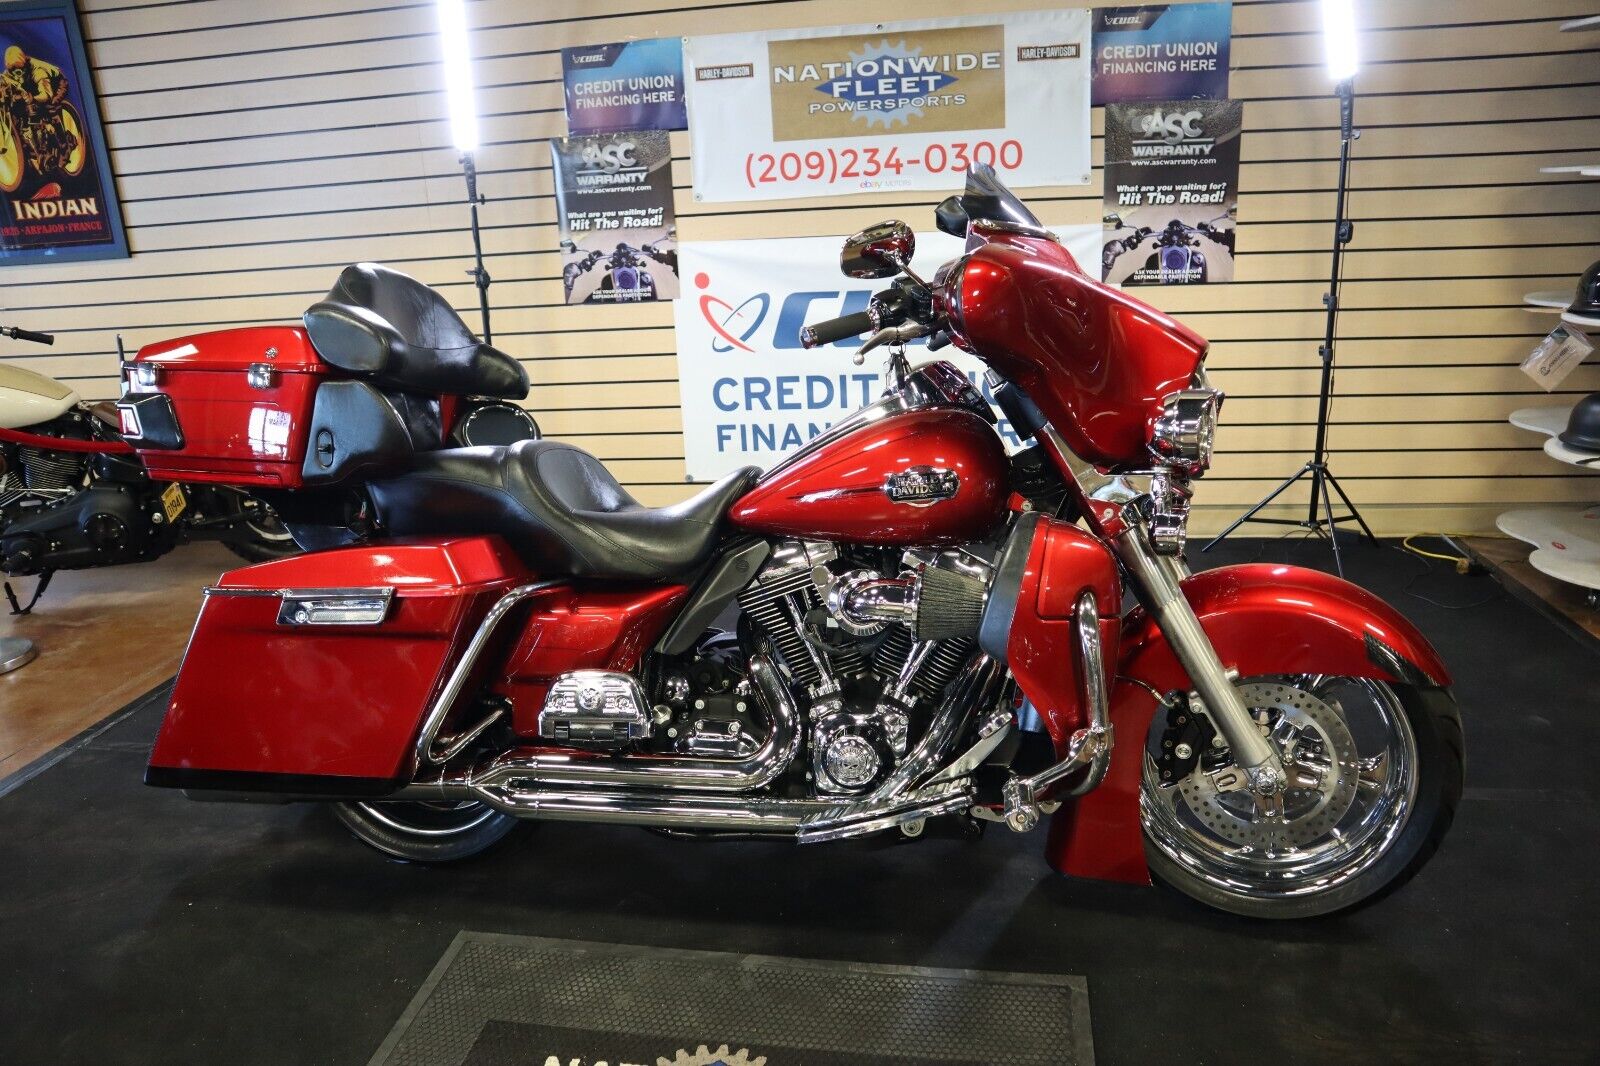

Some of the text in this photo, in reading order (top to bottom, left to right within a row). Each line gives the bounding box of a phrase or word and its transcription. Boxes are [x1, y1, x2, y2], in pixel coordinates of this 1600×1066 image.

[1021, 45, 1077, 59] HARLEY-DAVIDSON
[1102, 41, 1218, 60] CREDIT UNION
[773, 52, 1001, 83] NATIONWIDE
[1102, 59, 1217, 75] FINANCING HERE
[574, 75, 675, 95] CREDIT UNION
[832, 75, 942, 98] FLEET
[576, 91, 676, 109] FINANCING HERE
[808, 95, 967, 114] POWERSPORTS
[1142, 108, 1204, 145] ASC
[582, 142, 637, 174] ASC
[1131, 144, 1215, 157] WARRANTY
[746, 139, 1024, 188] (209)234-0300
[1130, 158, 1217, 166] www.ascwarranty.com
[576, 172, 648, 186] WARRANTY
[1117, 184, 1139, 192] What
[1157, 185, 1173, 193] you
[1175, 183, 1207, 191] waiting
[1209, 182, 1227, 190] for?
[577, 185, 652, 194] www.ascwarranty.com
[1118, 190, 1225, 205] Hit The Road!
[12, 197, 99, 220] INDIAN
[568, 211, 586, 219] What
[618, 208, 646, 216] waiting
[570, 215, 663, 231] Hit The Road!
[712, 374, 879, 411] CREDIT
